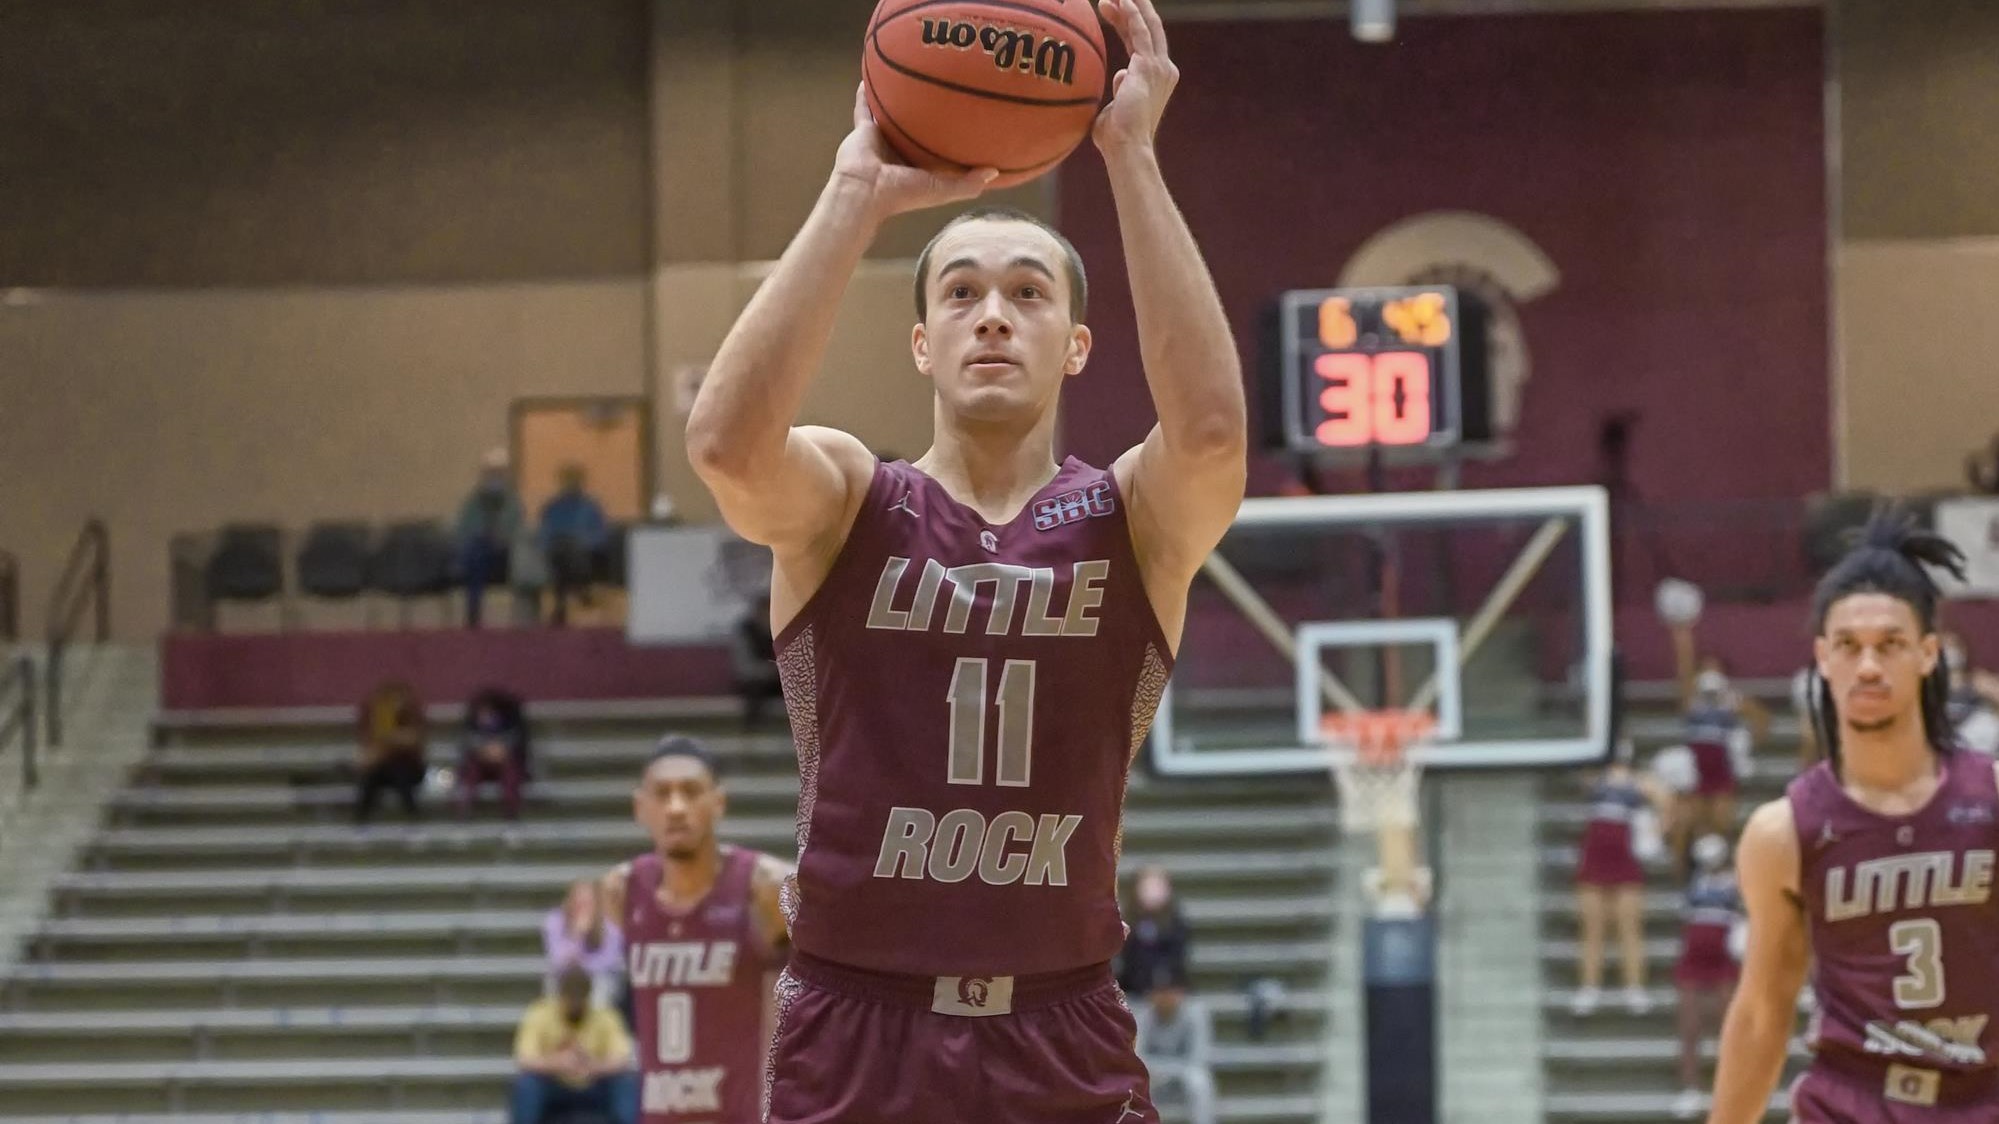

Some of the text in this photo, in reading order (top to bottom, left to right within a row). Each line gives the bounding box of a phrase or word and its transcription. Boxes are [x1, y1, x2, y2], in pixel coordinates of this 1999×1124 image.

[921, 15, 1076, 86] Wilson
[1318, 296, 1357, 349] 6
[1313, 351, 1431, 446] 30
[1032, 480, 1115, 531] SBC
[865, 556, 1110, 637] LITTLE
[946, 657, 1036, 787] 11
[873, 806, 1083, 887] ROCK
[1824, 850, 1996, 922] LITTLE
[629, 941, 737, 989] LITTLE
[1889, 918, 1946, 1010] 3
[656, 991, 694, 1065] 0
